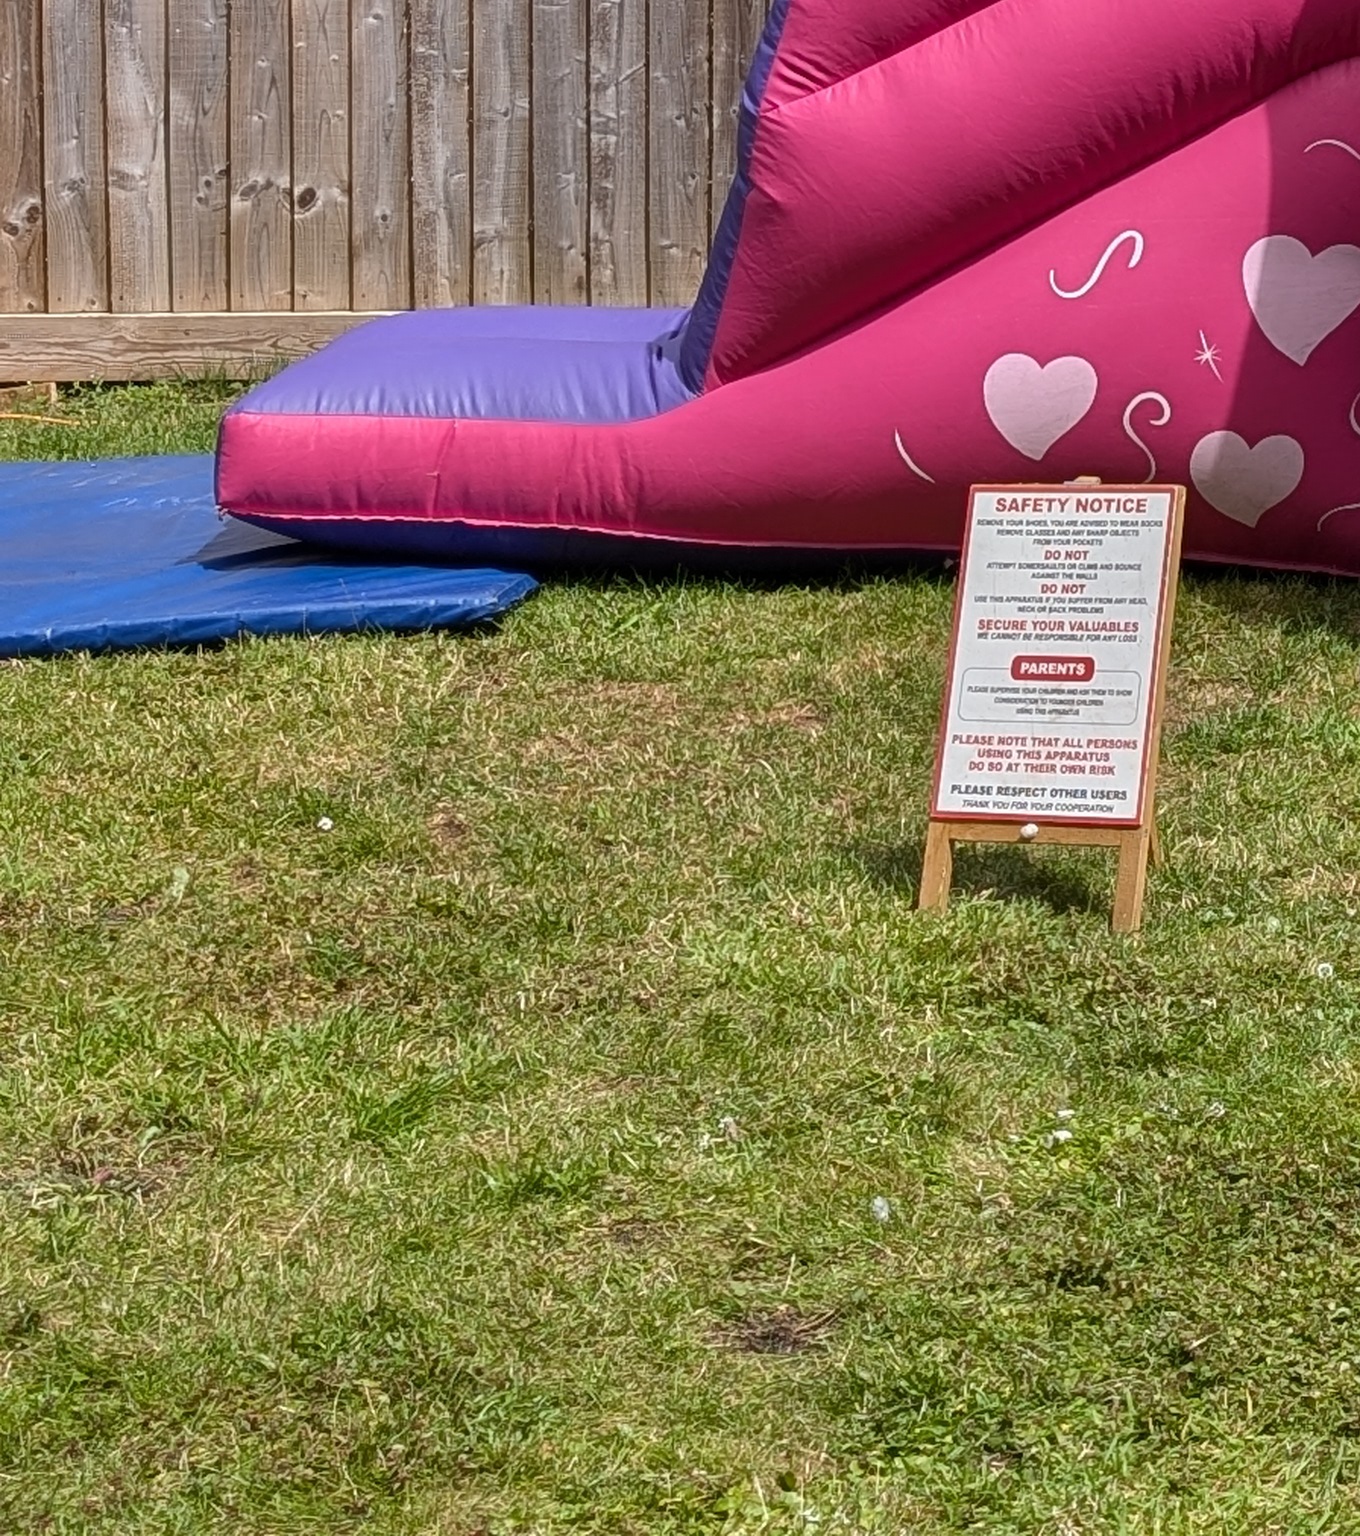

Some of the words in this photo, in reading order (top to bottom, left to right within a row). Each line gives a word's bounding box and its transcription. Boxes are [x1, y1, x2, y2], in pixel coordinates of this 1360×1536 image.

[995, 498, 1070, 512] SAFETY
[1076, 498, 1147, 513] NOTICE
[1044, 551, 1061, 560] DO
[1065, 551, 1089, 560] NOT
[1041, 584, 1058, 594] DO
[1061, 584, 1086, 594] NOT
[978, 619, 1027, 631] SECURE
[1031, 620, 1065, 632] YOUR
[1069, 621, 1139, 633] VALUABLES
[1019, 662, 1085, 676] PARENTS
[951, 735, 994, 746] PLEASE
[998, 736, 1027, 747] NOTE
[1031, 737, 1060, 748] THAT
[1063, 738, 1083, 748] ALL
[1086, 739, 1137, 750] PERSONS
[977, 748, 1012, 759] USING
[1017, 750, 1041, 760] THIS
[1044, 751, 1110, 761] APPARATUS
[969, 761, 985, 771] DO
[988, 762, 1002, 771] SO
[1006, 762, 1020, 772] AT
[1023, 763, 1057, 774] THEIR
[1060, 764, 1086, 775] OWN
[1089, 765, 1116, 776] RISK
[950, 784, 993, 795] PLEASE
[996, 786, 1047, 798] RESPECT
[1050, 788, 1087, 799] OTHER
[1091, 789, 1127, 800] USERS
